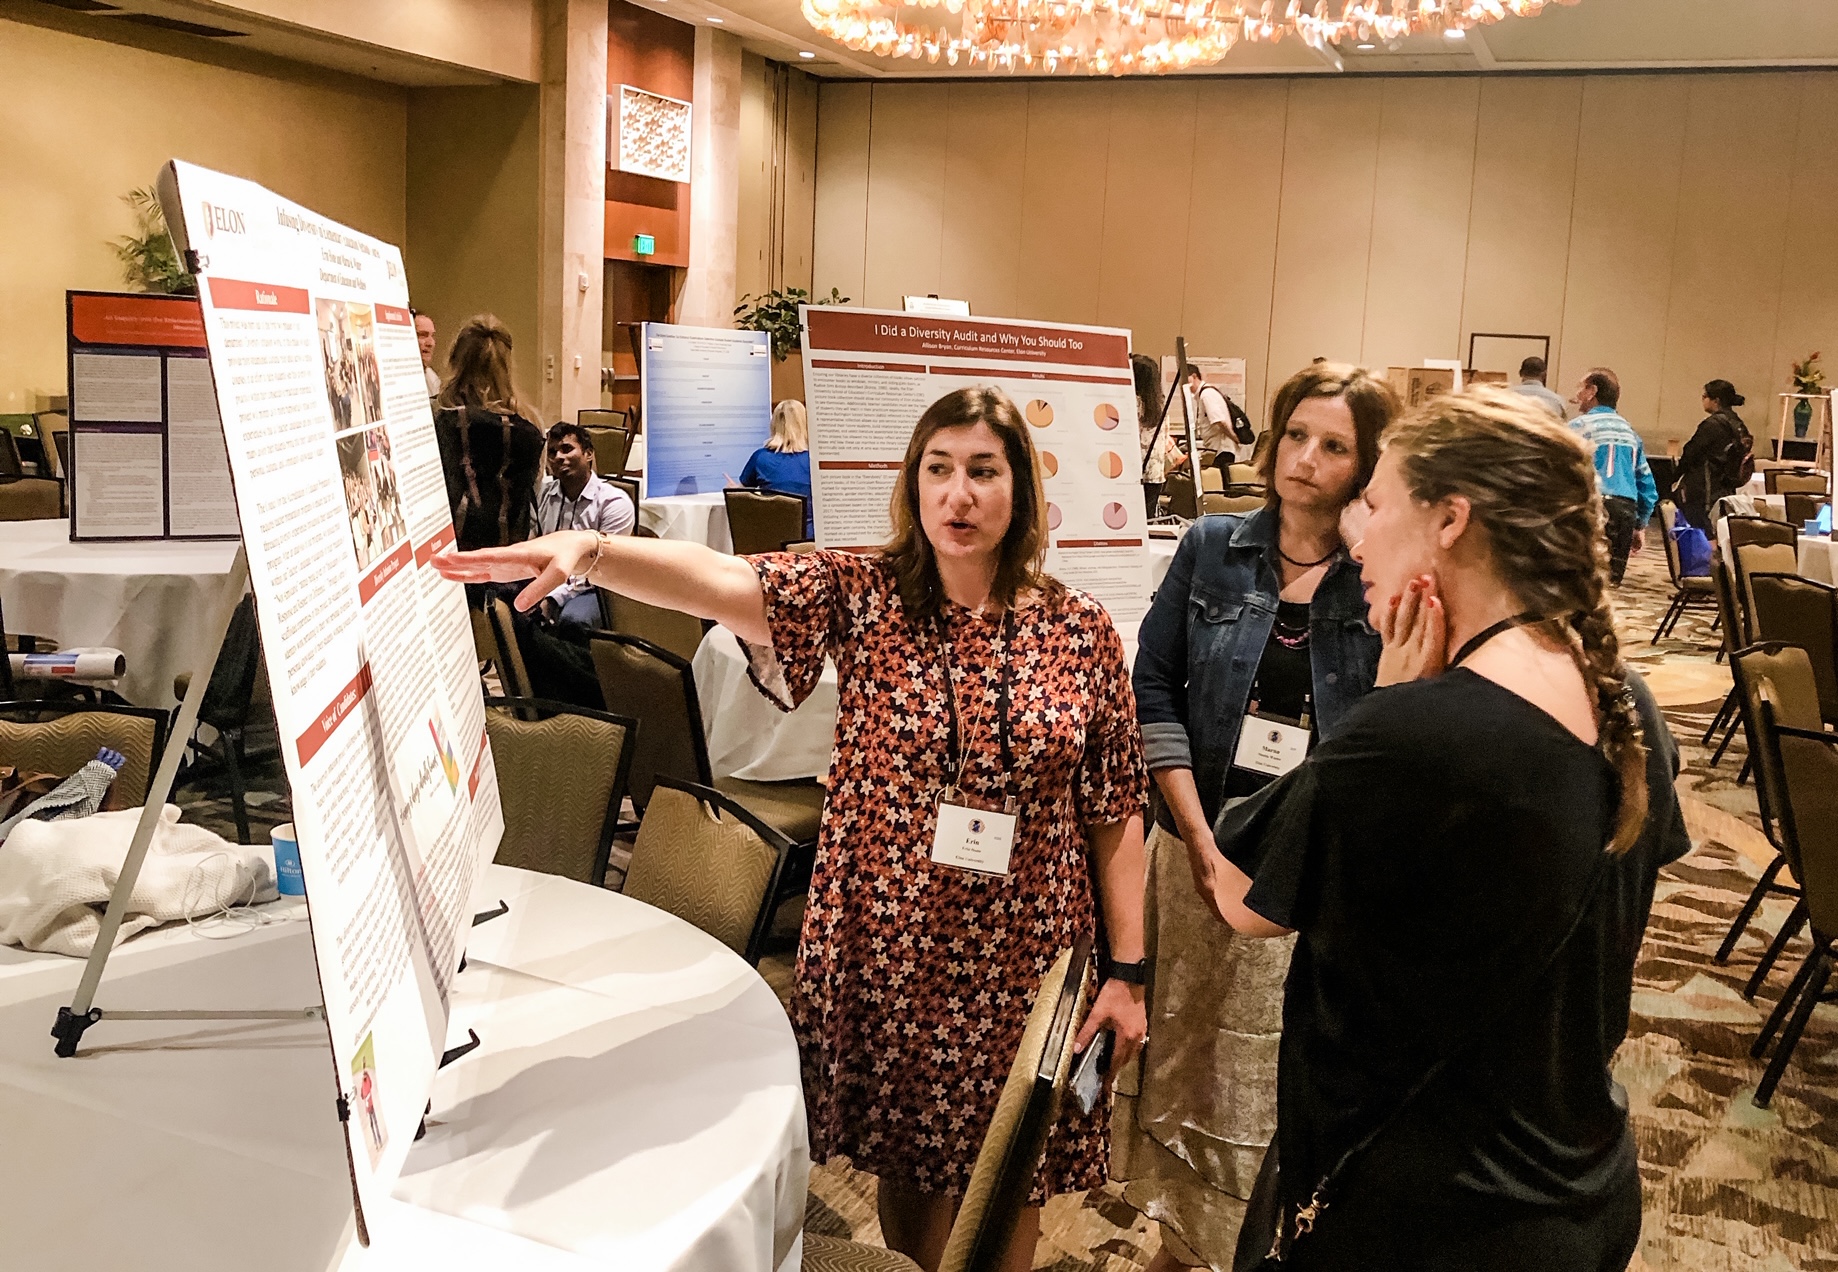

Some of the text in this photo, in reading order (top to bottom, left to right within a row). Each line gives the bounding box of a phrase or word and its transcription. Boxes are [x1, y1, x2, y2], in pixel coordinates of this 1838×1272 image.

[214, 206, 245, 234] ELON
[874, 324, 1083, 350] I Did a Diversity Audit and Why You Should Too
